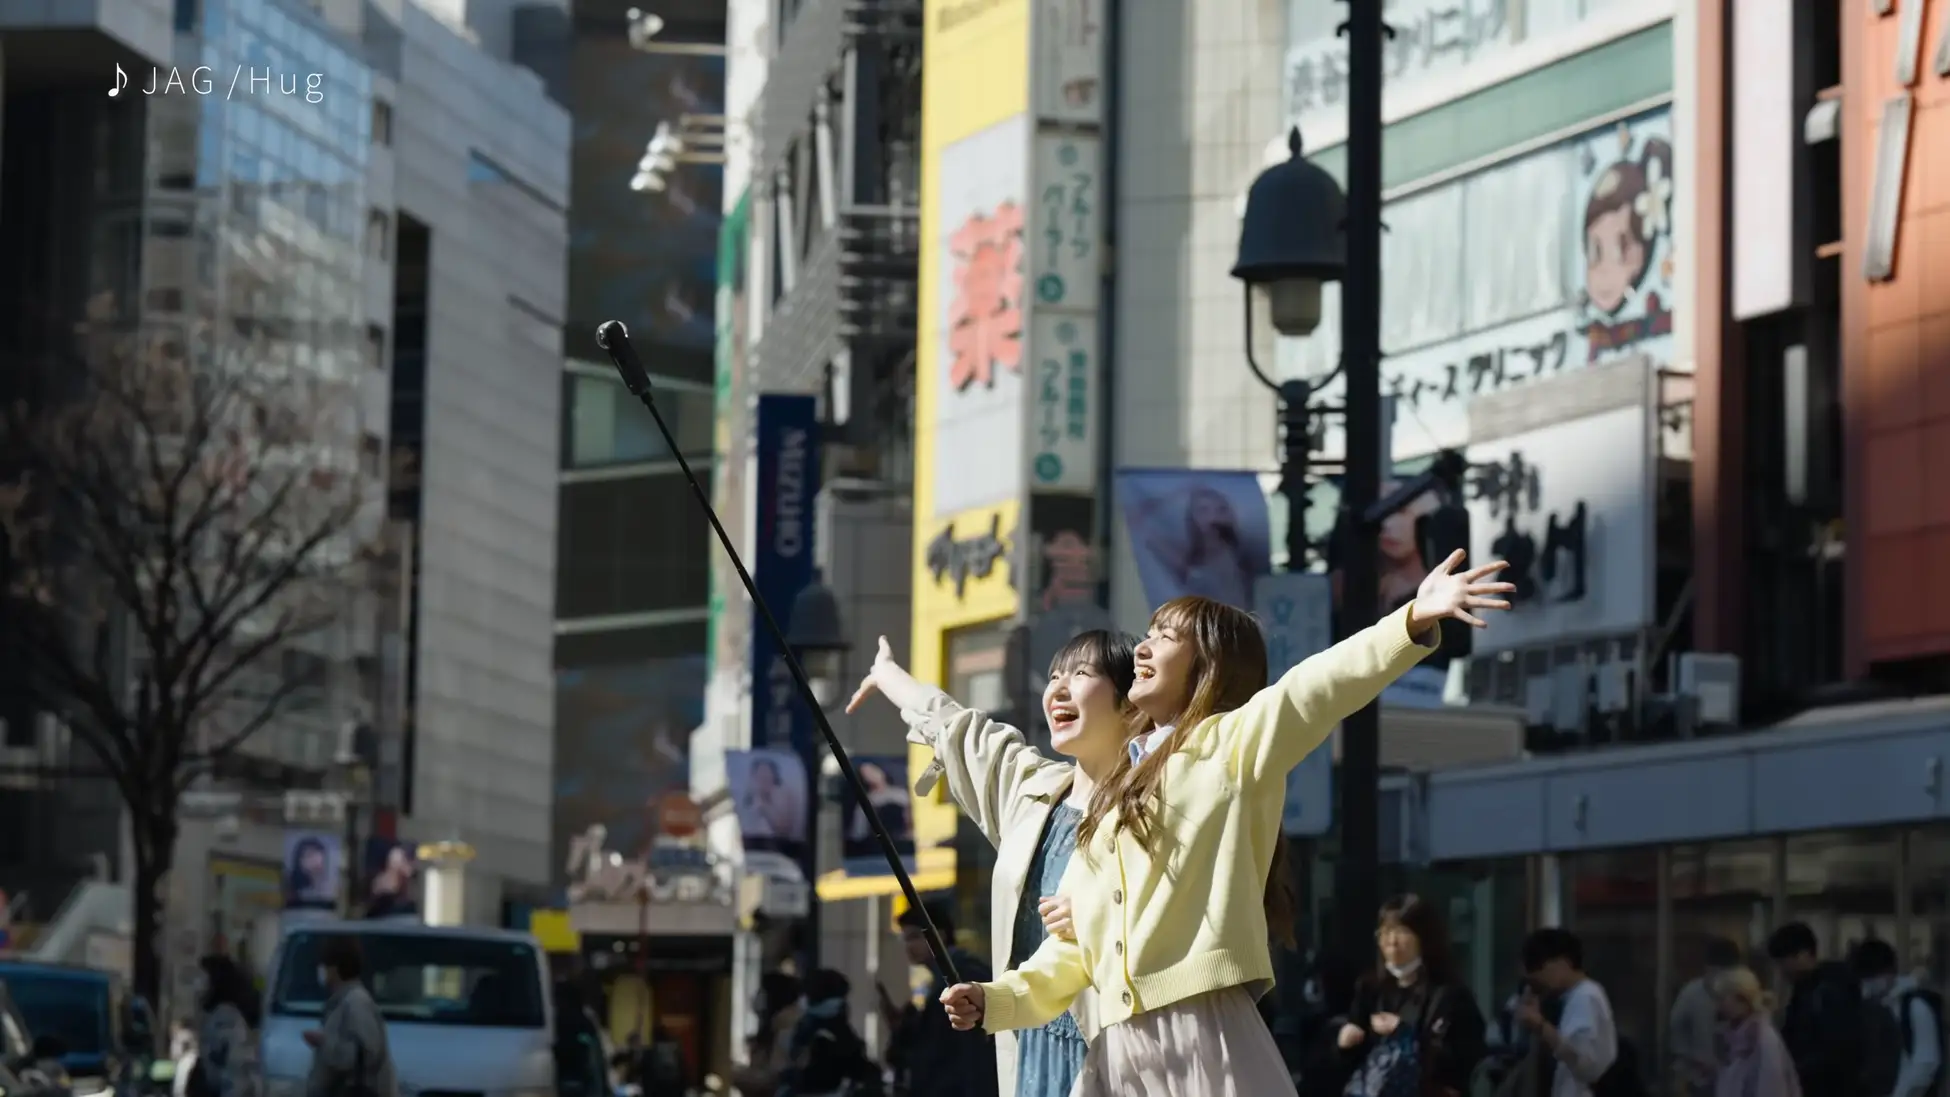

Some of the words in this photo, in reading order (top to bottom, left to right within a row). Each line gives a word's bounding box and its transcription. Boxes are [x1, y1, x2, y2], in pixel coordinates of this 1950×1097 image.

[1387, 331, 1568, 407] ディースクリニック
